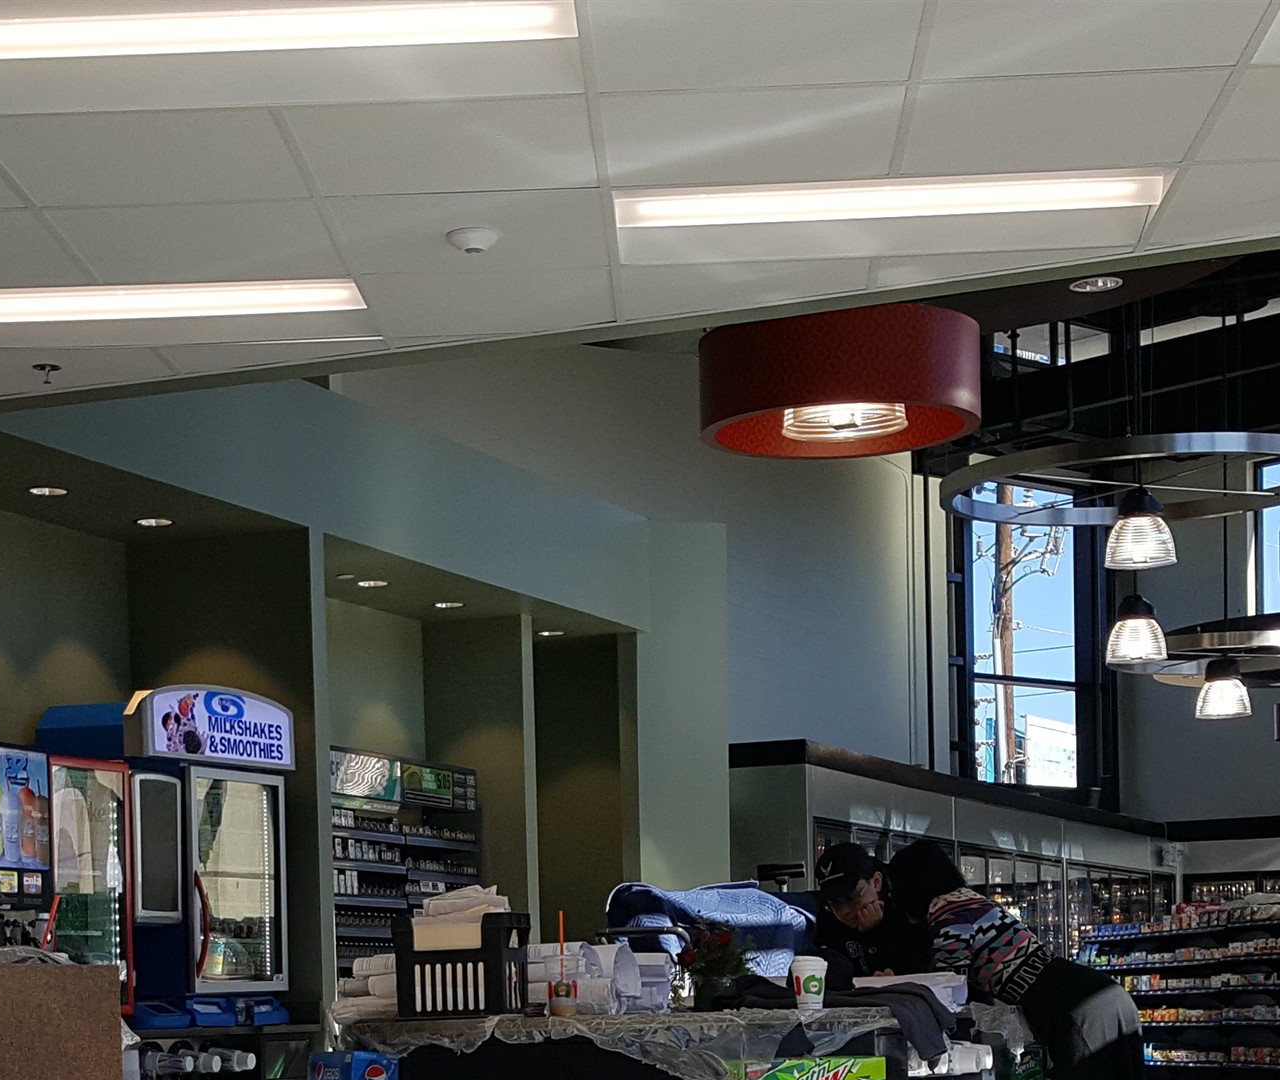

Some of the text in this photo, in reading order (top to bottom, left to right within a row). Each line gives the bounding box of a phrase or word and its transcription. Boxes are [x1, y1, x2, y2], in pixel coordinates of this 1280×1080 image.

[208, 716, 282, 741] MILKSHAKES
[209, 736, 283, 760] & SMOOTHIES
[24, 876, 42, 886] cola
[1015, 1060, 1036, 1074] Sprite
